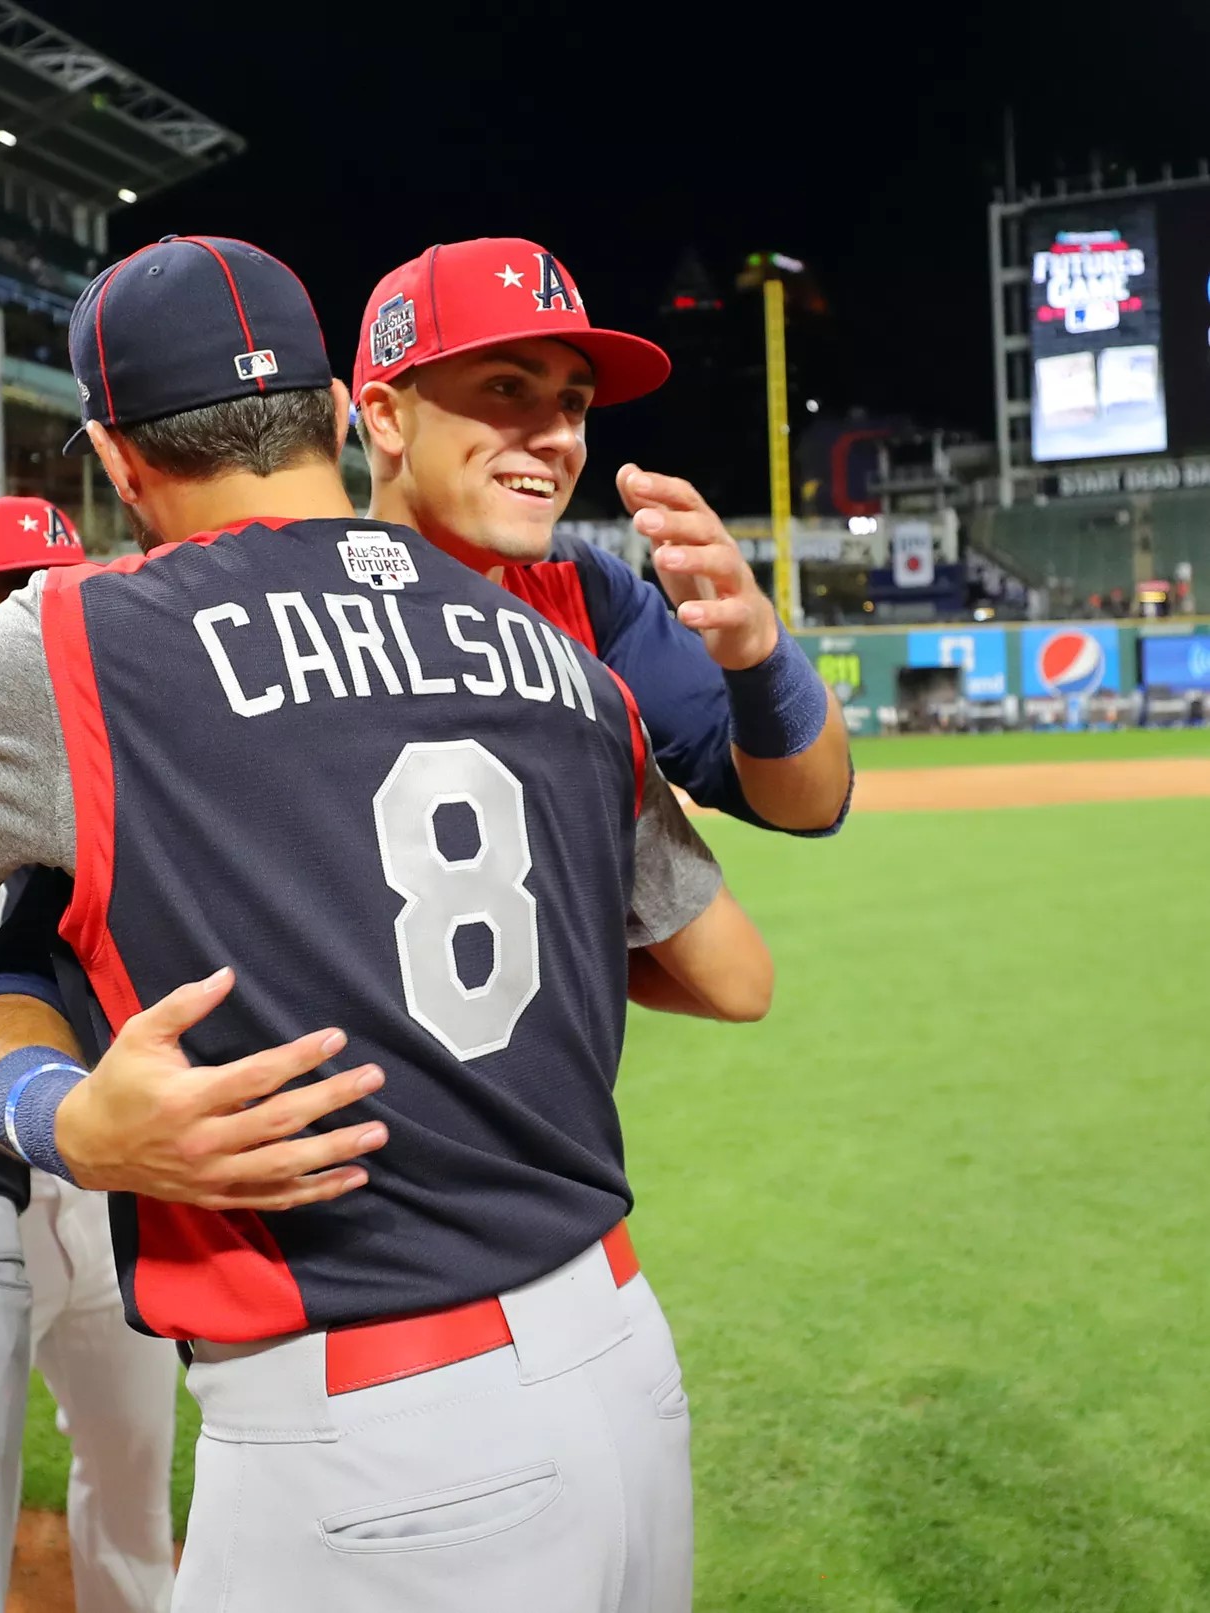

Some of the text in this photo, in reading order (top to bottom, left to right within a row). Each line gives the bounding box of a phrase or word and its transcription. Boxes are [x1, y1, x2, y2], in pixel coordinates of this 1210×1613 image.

[532, 252, 578, 313] A
[1033, 248, 1145, 284] FUTURES
[1047, 278, 1130, 308] GAME
[43, 506, 72, 548] A
[348, 558, 410, 573] FUTURES
[193, 591, 596, 721] CARLSON
[373, 738, 541, 1062] 8
